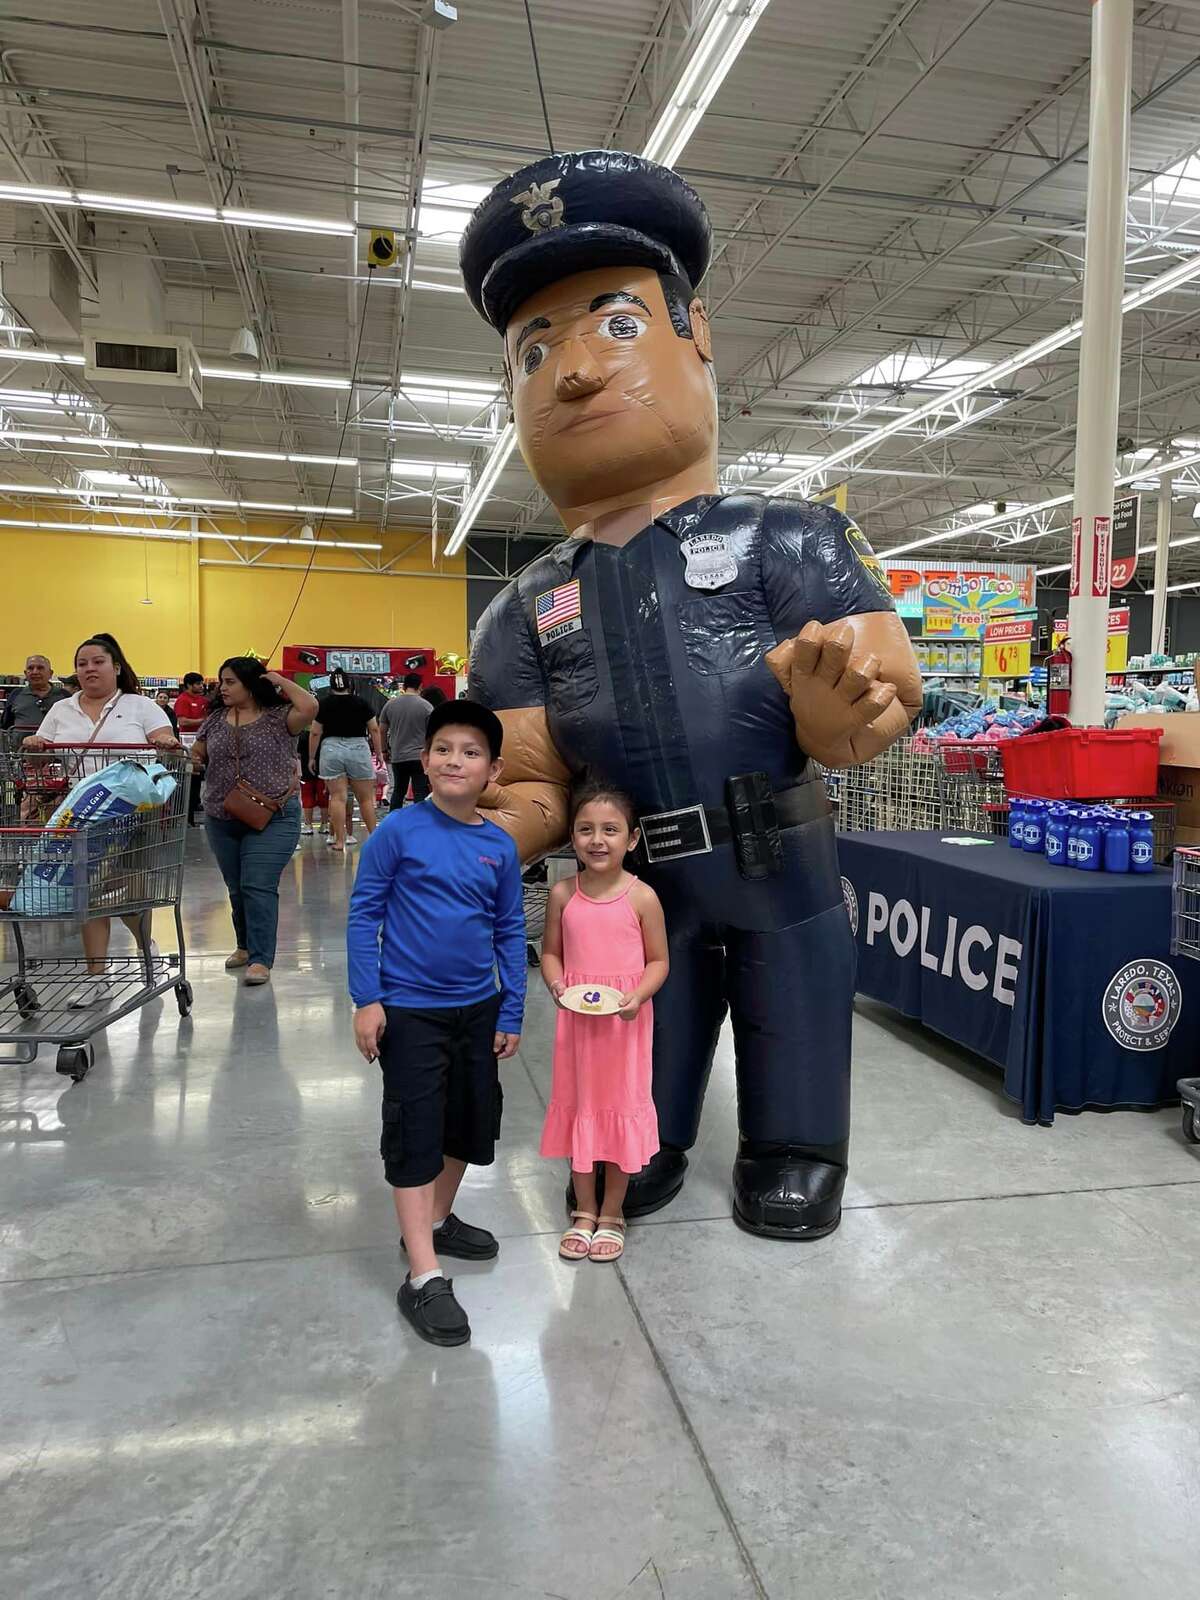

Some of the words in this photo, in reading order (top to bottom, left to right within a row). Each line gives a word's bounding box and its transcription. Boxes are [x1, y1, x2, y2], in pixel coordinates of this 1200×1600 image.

[1120, 500, 1133, 508] Food
[689, 534, 724, 547] LAREDO
[690, 543, 725, 554] POLICE
[1111, 564, 1127, 581] 22
[928, 575, 980, 597] Combo
[980, 576, 1015, 594] Loco
[957, 614, 985, 625] free!
[545, 622, 574, 642] POLICE
[990, 626, 1004, 637] LOW
[1005, 624, 1026, 635] PRICES
[330, 651, 386, 672] START
[866, 891, 1023, 1009] POLICE
[1112, 1020, 1143, 1046] PROTECT
[1145, 1038, 1152, 1046] &
